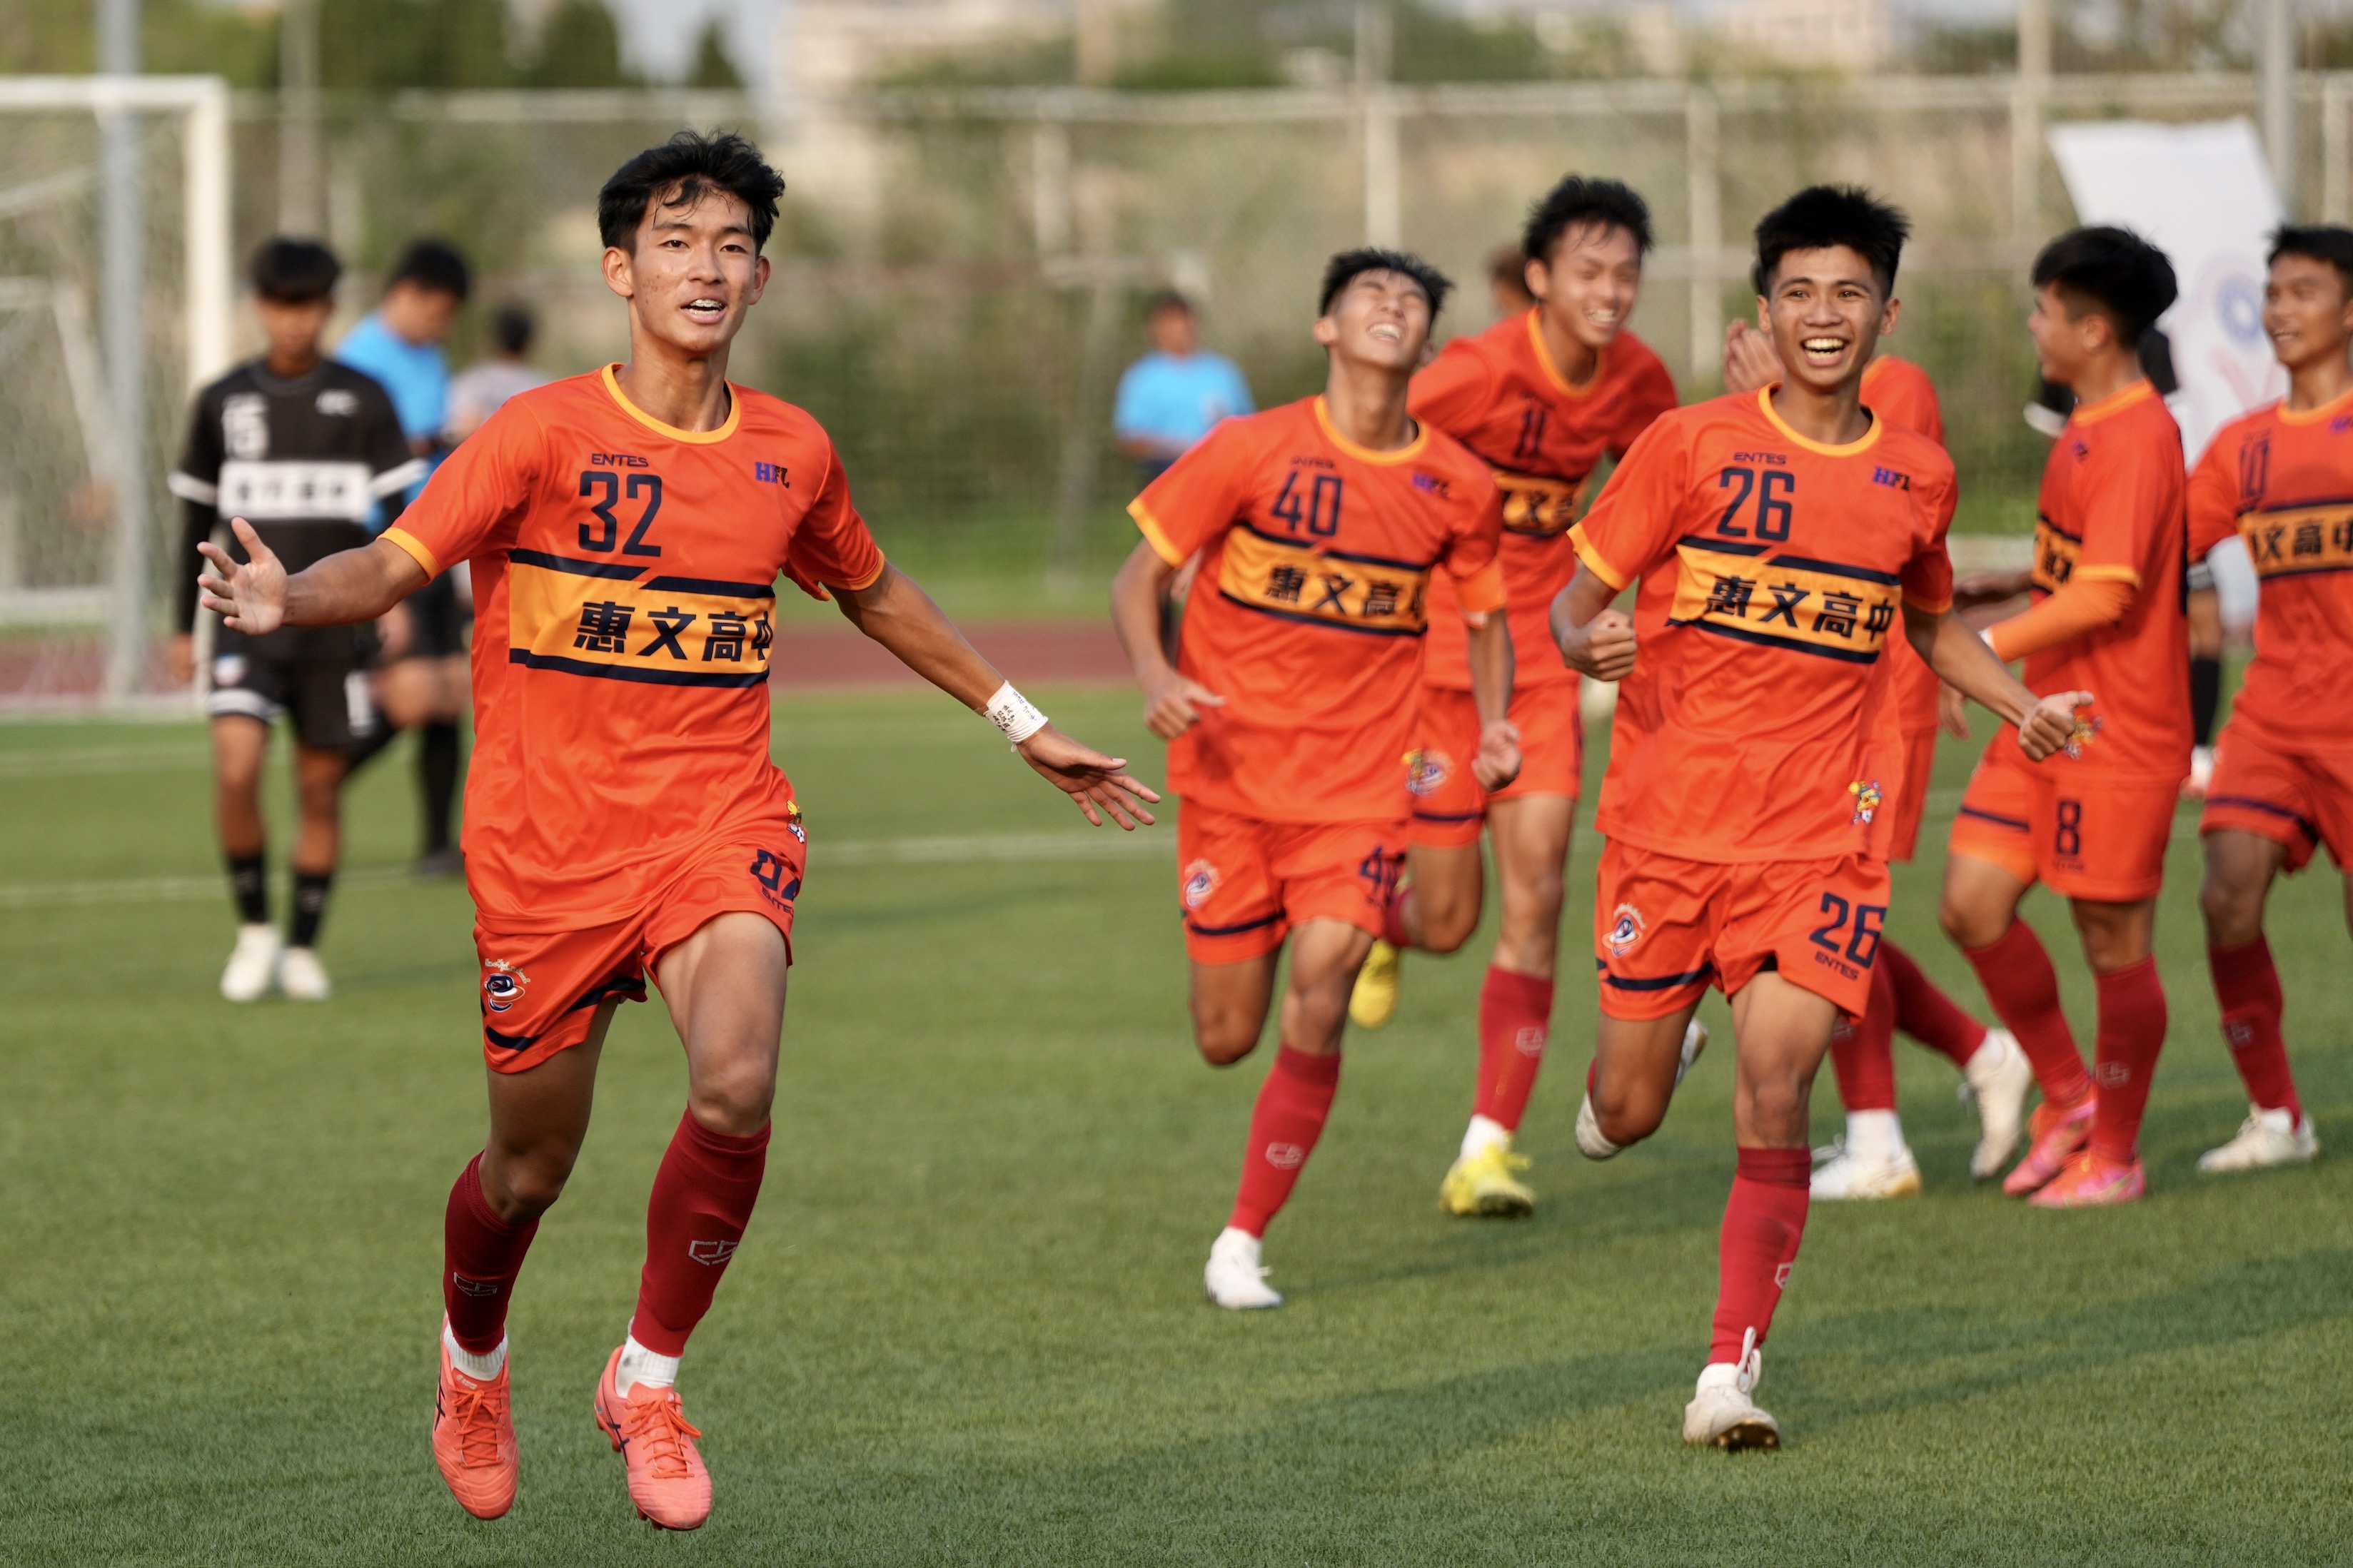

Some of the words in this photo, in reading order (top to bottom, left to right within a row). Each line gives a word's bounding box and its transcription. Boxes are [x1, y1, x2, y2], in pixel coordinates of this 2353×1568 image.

[591, 453, 649, 467] ENTES
[1733, 452, 1786, 465] ENTES
[578, 471, 662, 557] 32
[1273, 471, 1342, 536] 40
[1717, 467, 1794, 542] 26
[1703, 575, 1895, 642] 惠文高中
[2057, 800, 2082, 855] 8
[1809, 891, 1887, 969] 26
[1815, 951, 1859, 981] ENTES
